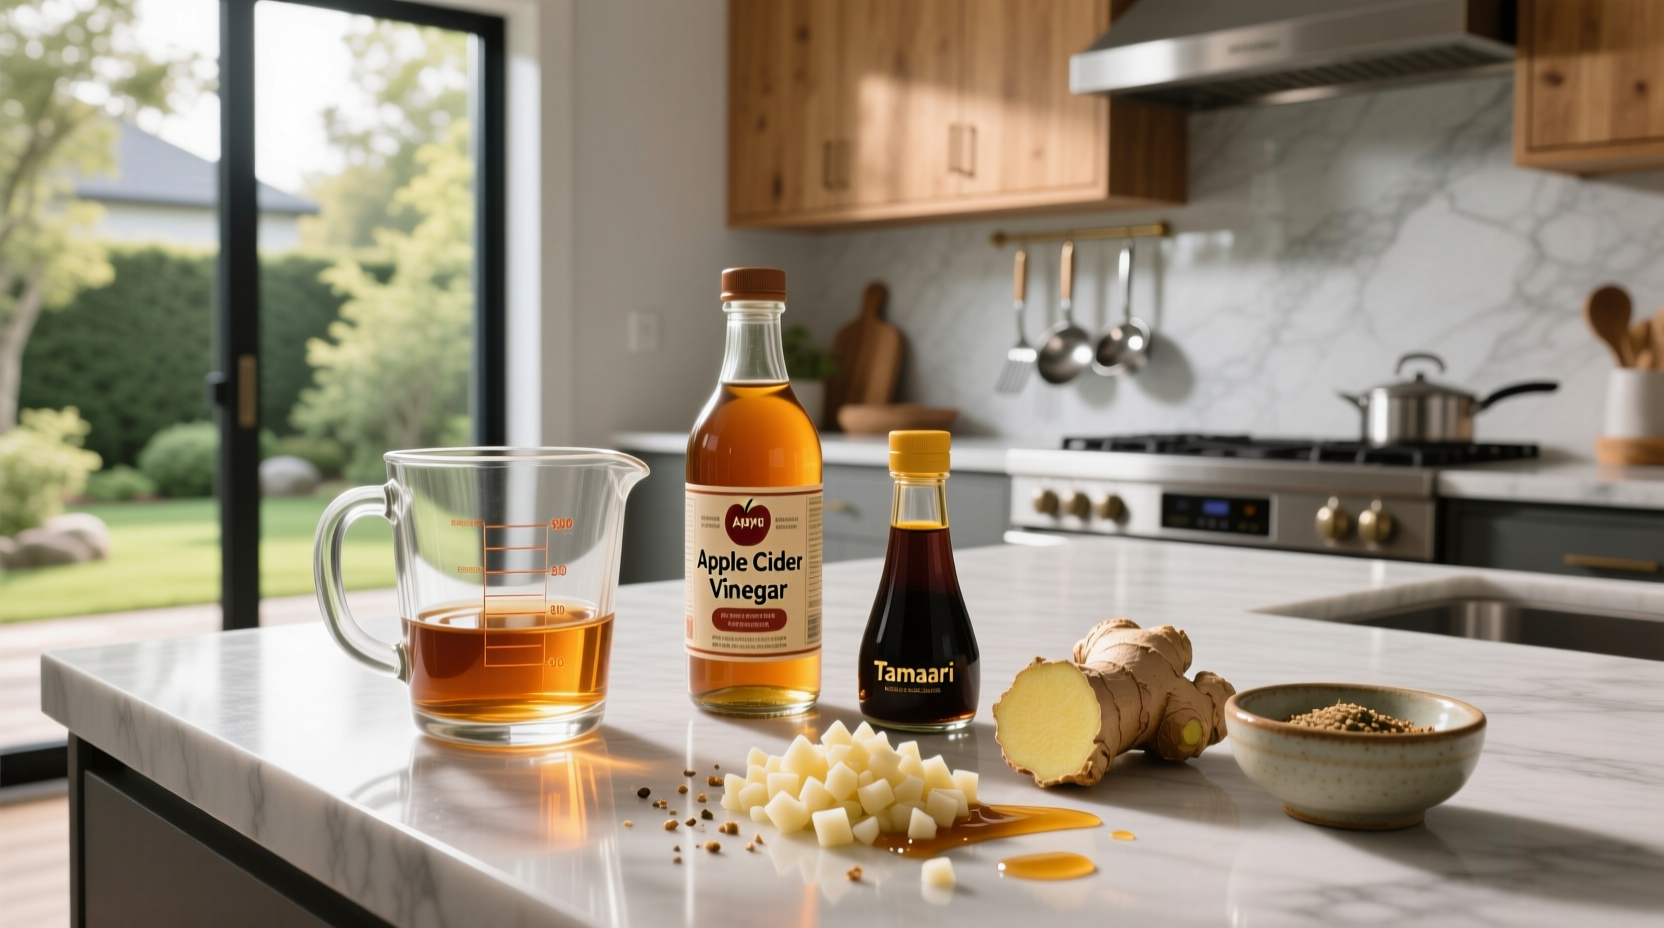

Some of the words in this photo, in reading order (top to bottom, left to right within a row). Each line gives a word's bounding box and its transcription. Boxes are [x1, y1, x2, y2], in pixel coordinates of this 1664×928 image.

[697, 549, 748, 575] Apple
[752, 550, 803, 572] Cider
[709, 577, 788, 606] Vinegar
[874, 660, 954, 683] Tamaari
